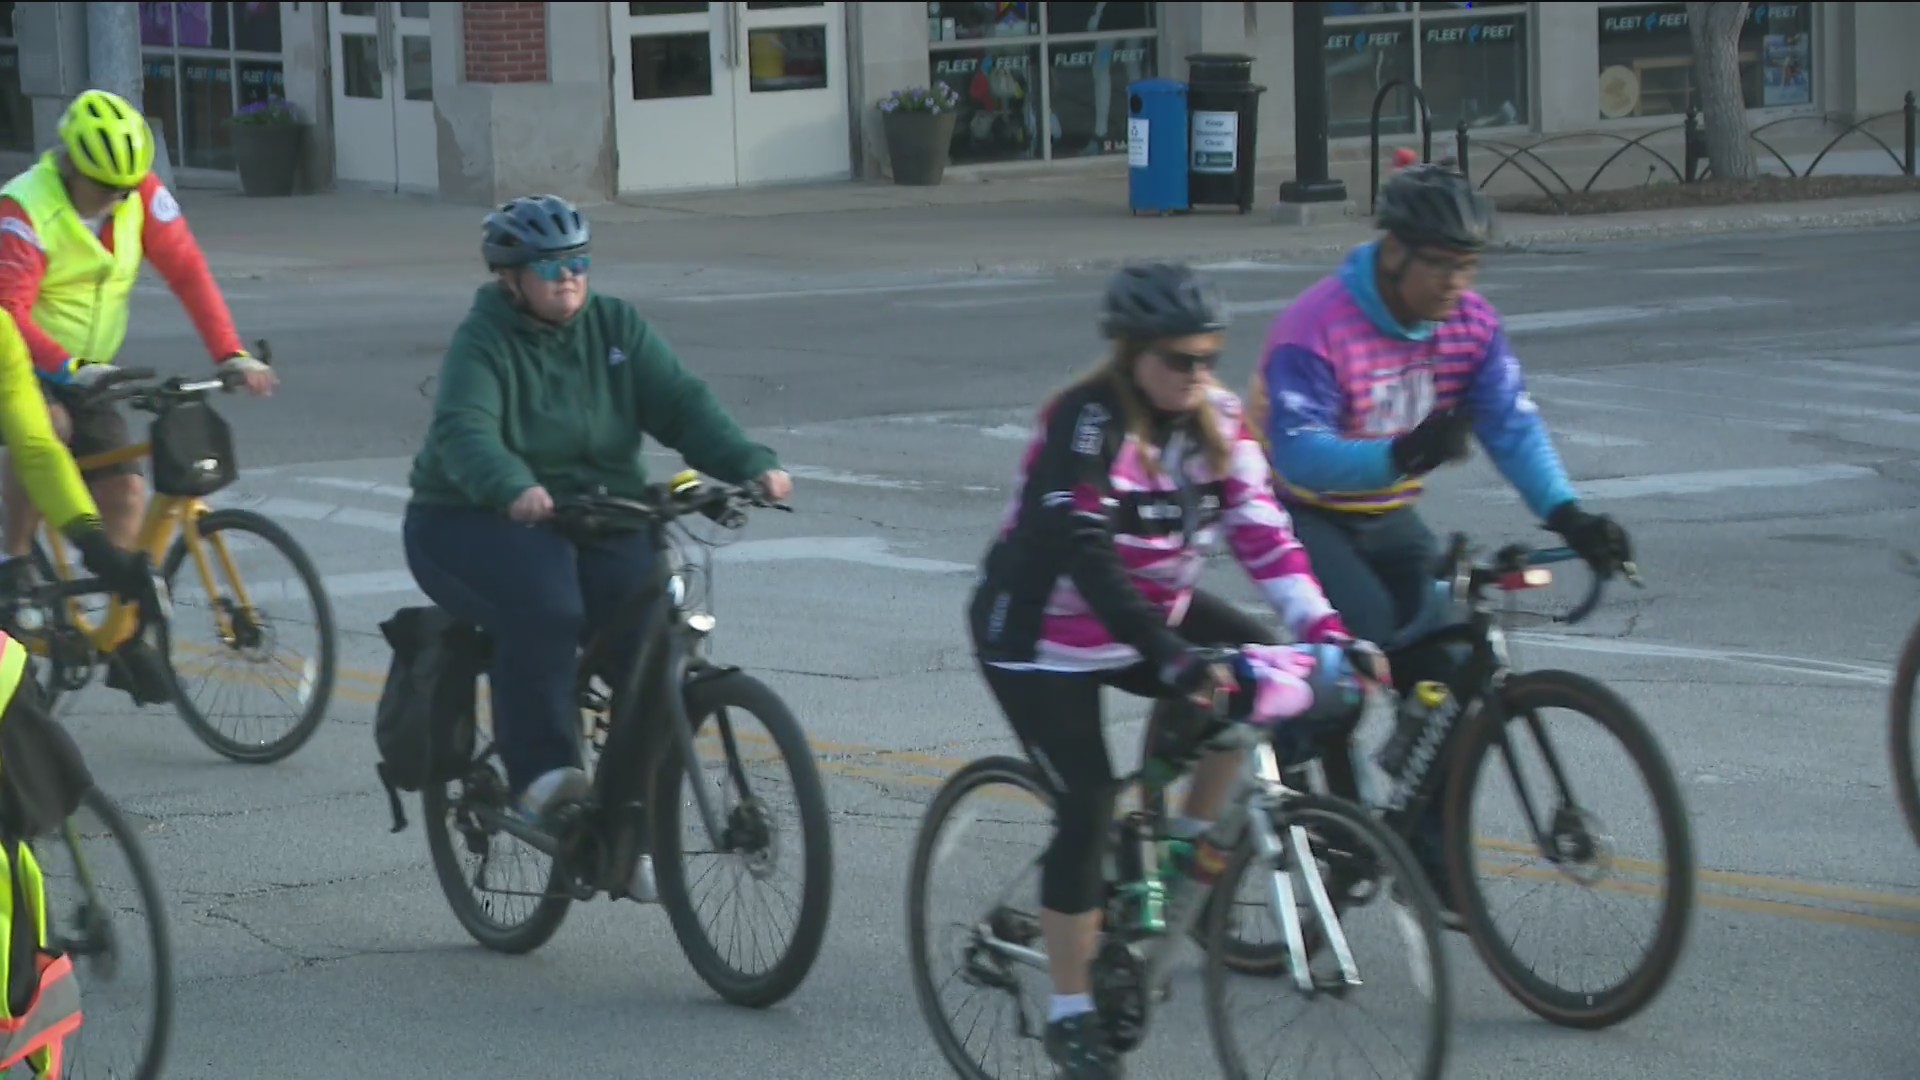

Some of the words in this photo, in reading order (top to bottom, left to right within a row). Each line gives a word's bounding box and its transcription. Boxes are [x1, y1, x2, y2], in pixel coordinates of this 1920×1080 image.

[1605, 16, 1642, 31] FLEET
[1659, 13, 1688, 27] FEET
[1324, 34, 1352, 49] EET
[1368, 31, 1401, 46] FEET
[1427, 27, 1465, 42] FLEET
[1482, 24, 1515, 38] FEET
[937, 59, 977, 73] FLEET
[995, 56, 1030, 70] FEET
[1055, 51, 1094, 66] FLEET
[1113, 48, 1145, 62] FEET
